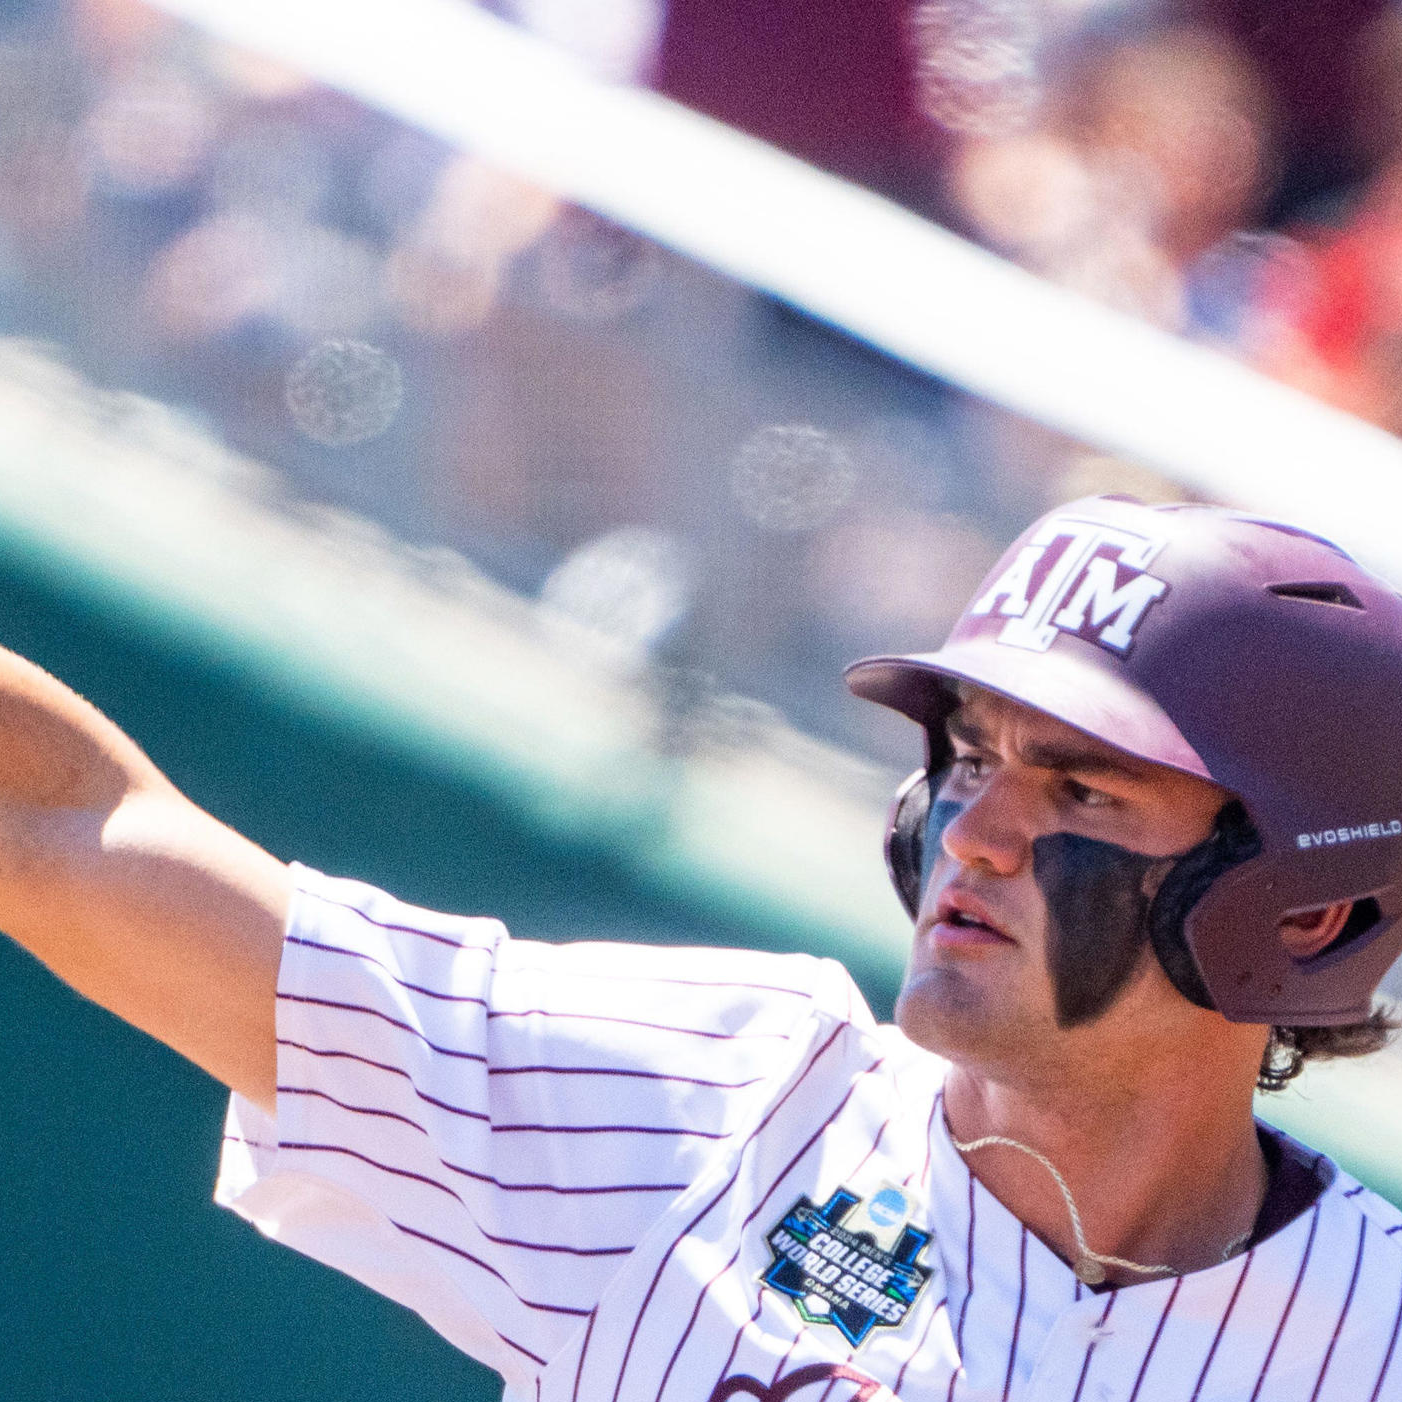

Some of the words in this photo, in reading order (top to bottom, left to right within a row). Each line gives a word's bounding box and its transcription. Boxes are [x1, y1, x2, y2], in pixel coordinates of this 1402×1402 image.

[771, 1230, 841, 1283] WORLD
[833, 1274, 907, 1322] SERIES
[809, 1232, 895, 1289] COLLEGE
[805, 1278, 849, 1309] OMAHA
